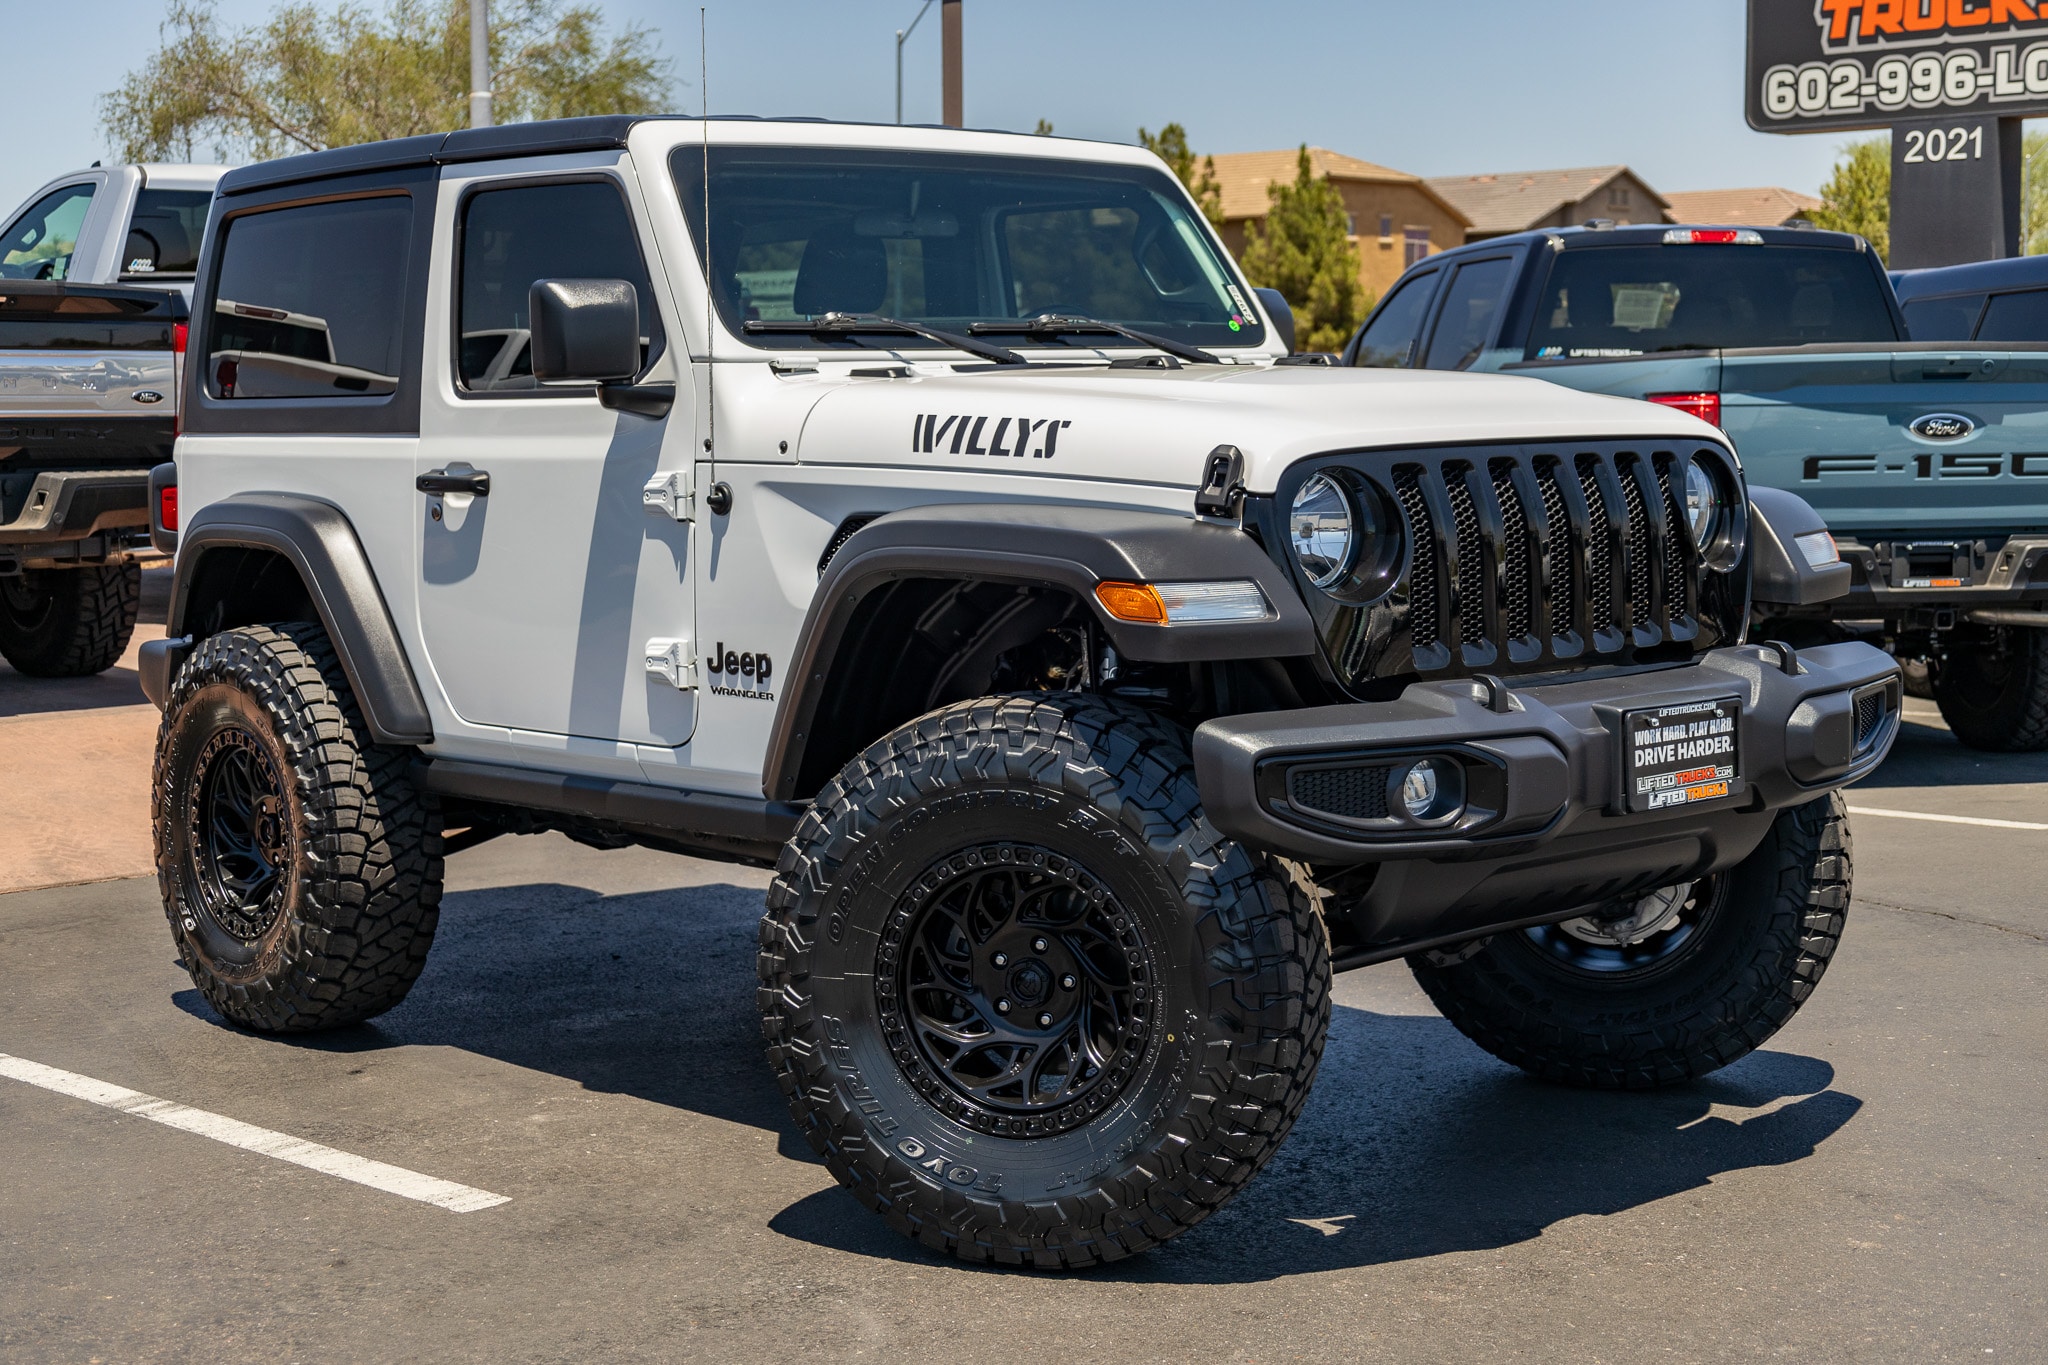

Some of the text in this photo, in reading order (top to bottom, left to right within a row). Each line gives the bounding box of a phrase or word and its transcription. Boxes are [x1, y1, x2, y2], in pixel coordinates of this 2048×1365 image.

[1823, 0, 2048, 40] TRUCK
[1903, 126, 1983, 163] 2021
[912, 414, 1072, 459] WILLYS
[1925, 419, 1960, 435] Ford
[706, 642, 772, 684] Jeep
[710, 685, 774, 701] WRANGLER
[1634, 717, 1734, 747] WORK HARD. PLAY HARD.
[1634, 735, 1734, 767] DRIVE HARDER.
[1637, 773, 1676, 793] LIFTED
[1648, 788, 1686, 809] LIFTED
[828, 841, 886, 943] OPEN
[822, 1014, 900, 1139] TIRES
[895, 1136, 1004, 1193] TOYO
